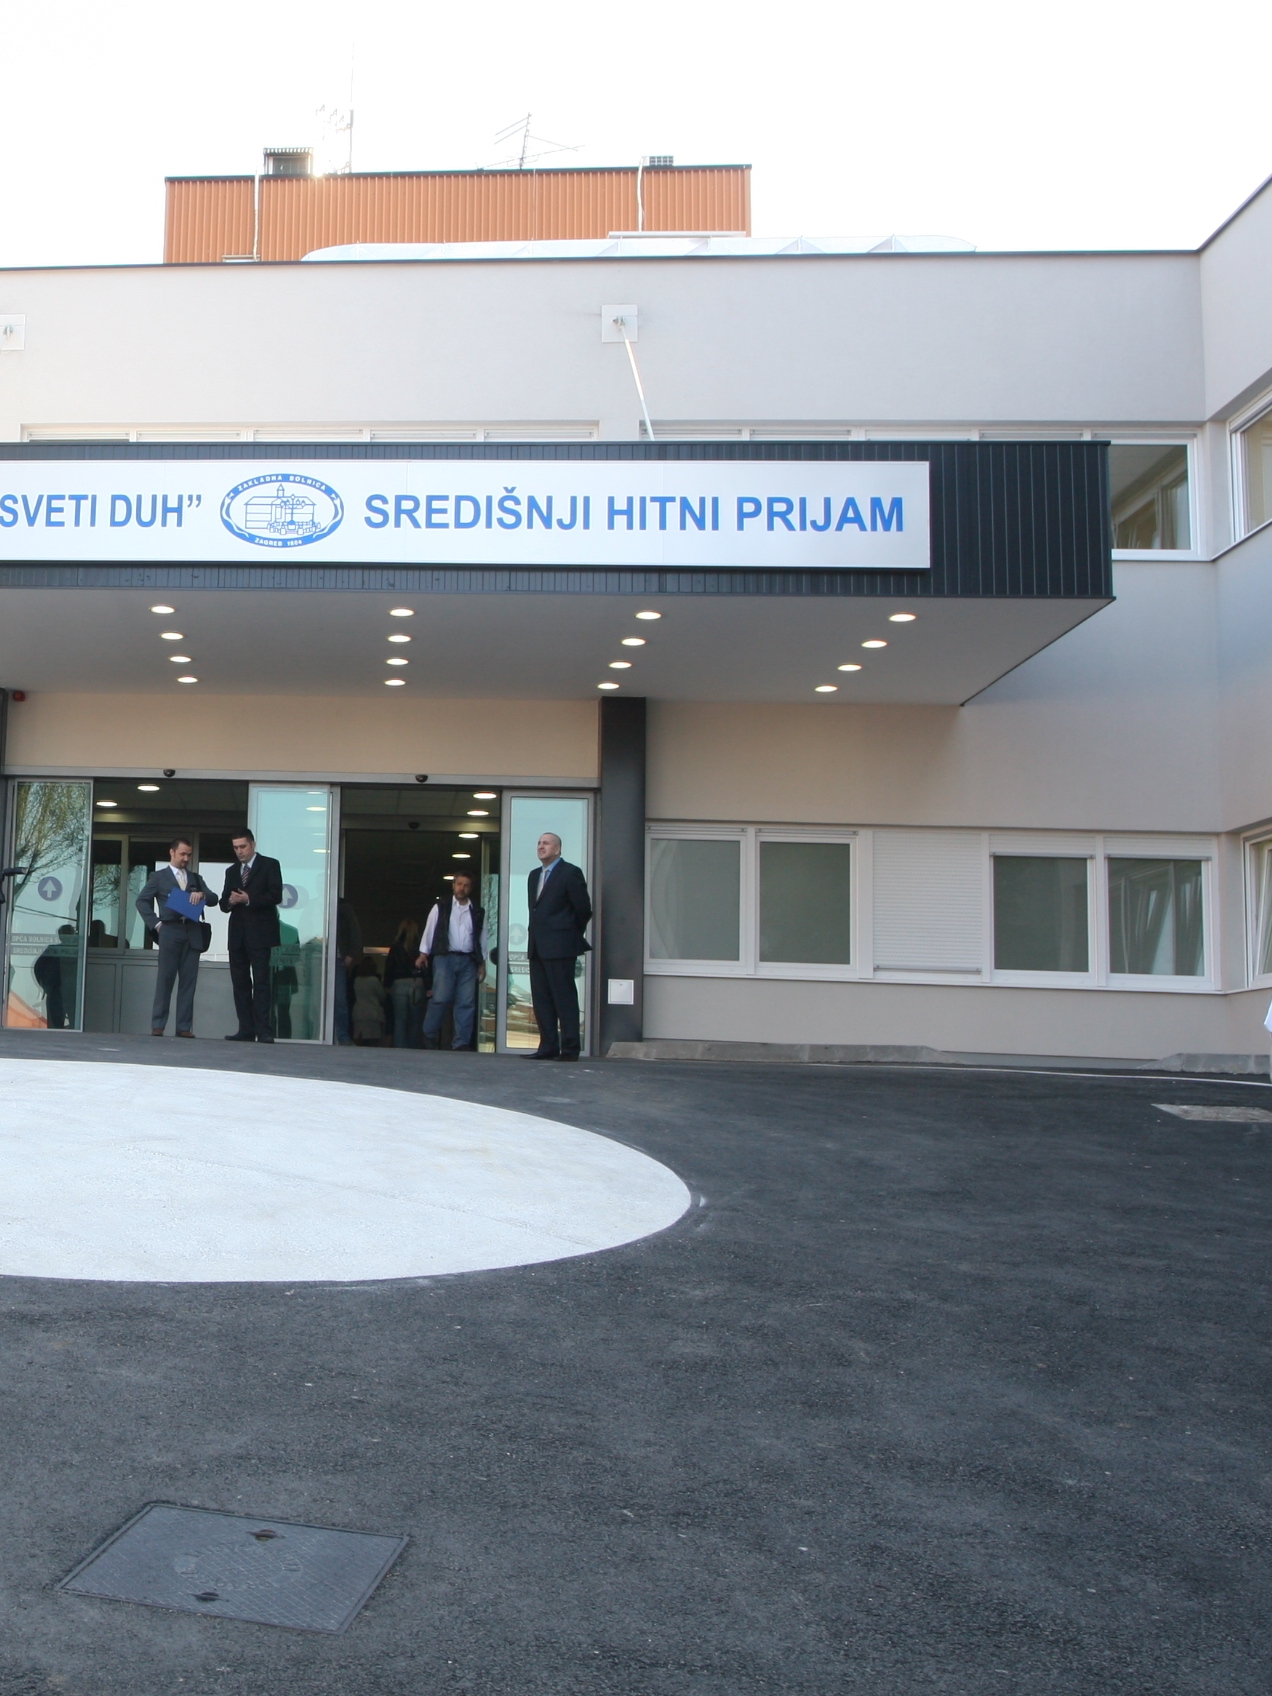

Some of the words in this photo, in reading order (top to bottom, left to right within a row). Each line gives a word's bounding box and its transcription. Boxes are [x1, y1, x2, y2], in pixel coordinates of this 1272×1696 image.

[237, 475, 283, 491] ZAKLADNA
[289, 475, 326, 491] BOLNICA
[363, 486, 591, 531] SREDIŠNJI
[606, 495, 720, 531] HITNI
[736, 496, 906, 533] PRIJAM
[254, 537, 283, 547] ZAGREB
